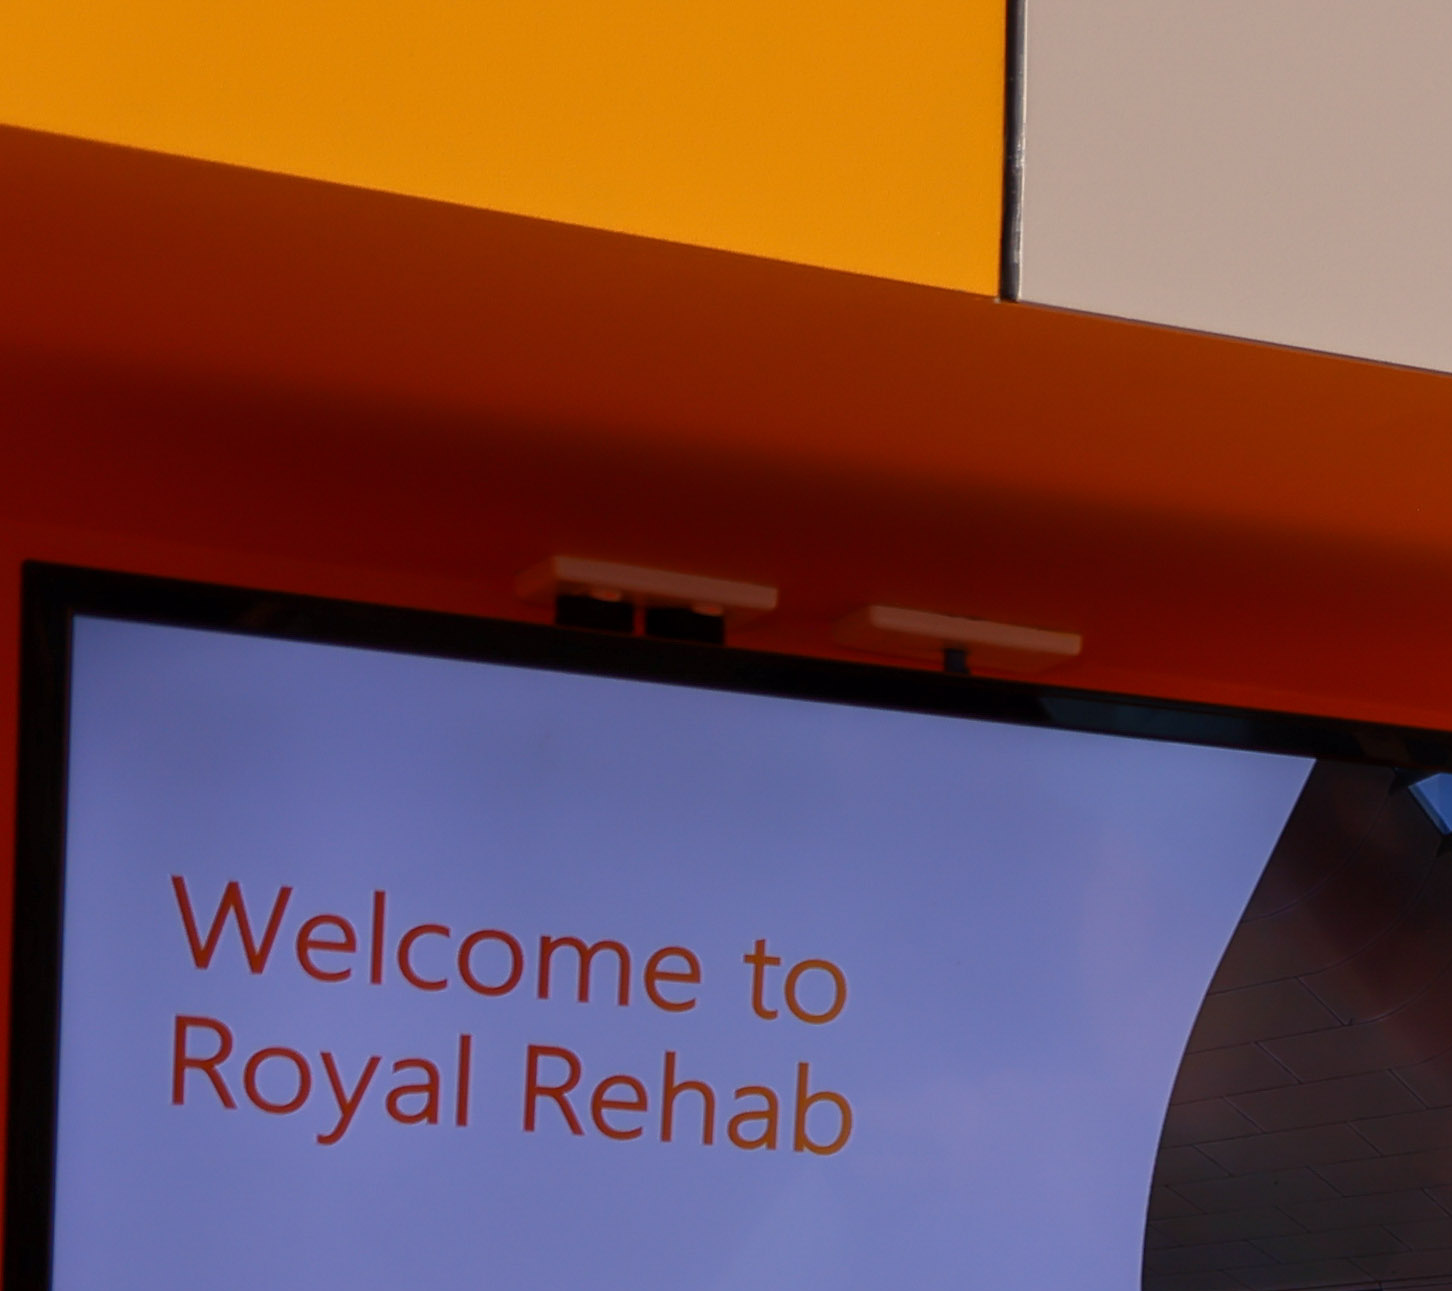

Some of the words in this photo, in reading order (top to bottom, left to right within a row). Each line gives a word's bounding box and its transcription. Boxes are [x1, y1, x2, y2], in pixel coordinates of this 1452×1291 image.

[170, 874, 702, 1013] Welcome
[742, 937, 848, 1025] to
[170, 1014, 473, 1147] Royal
[522, 1043, 854, 1156] Rehab
